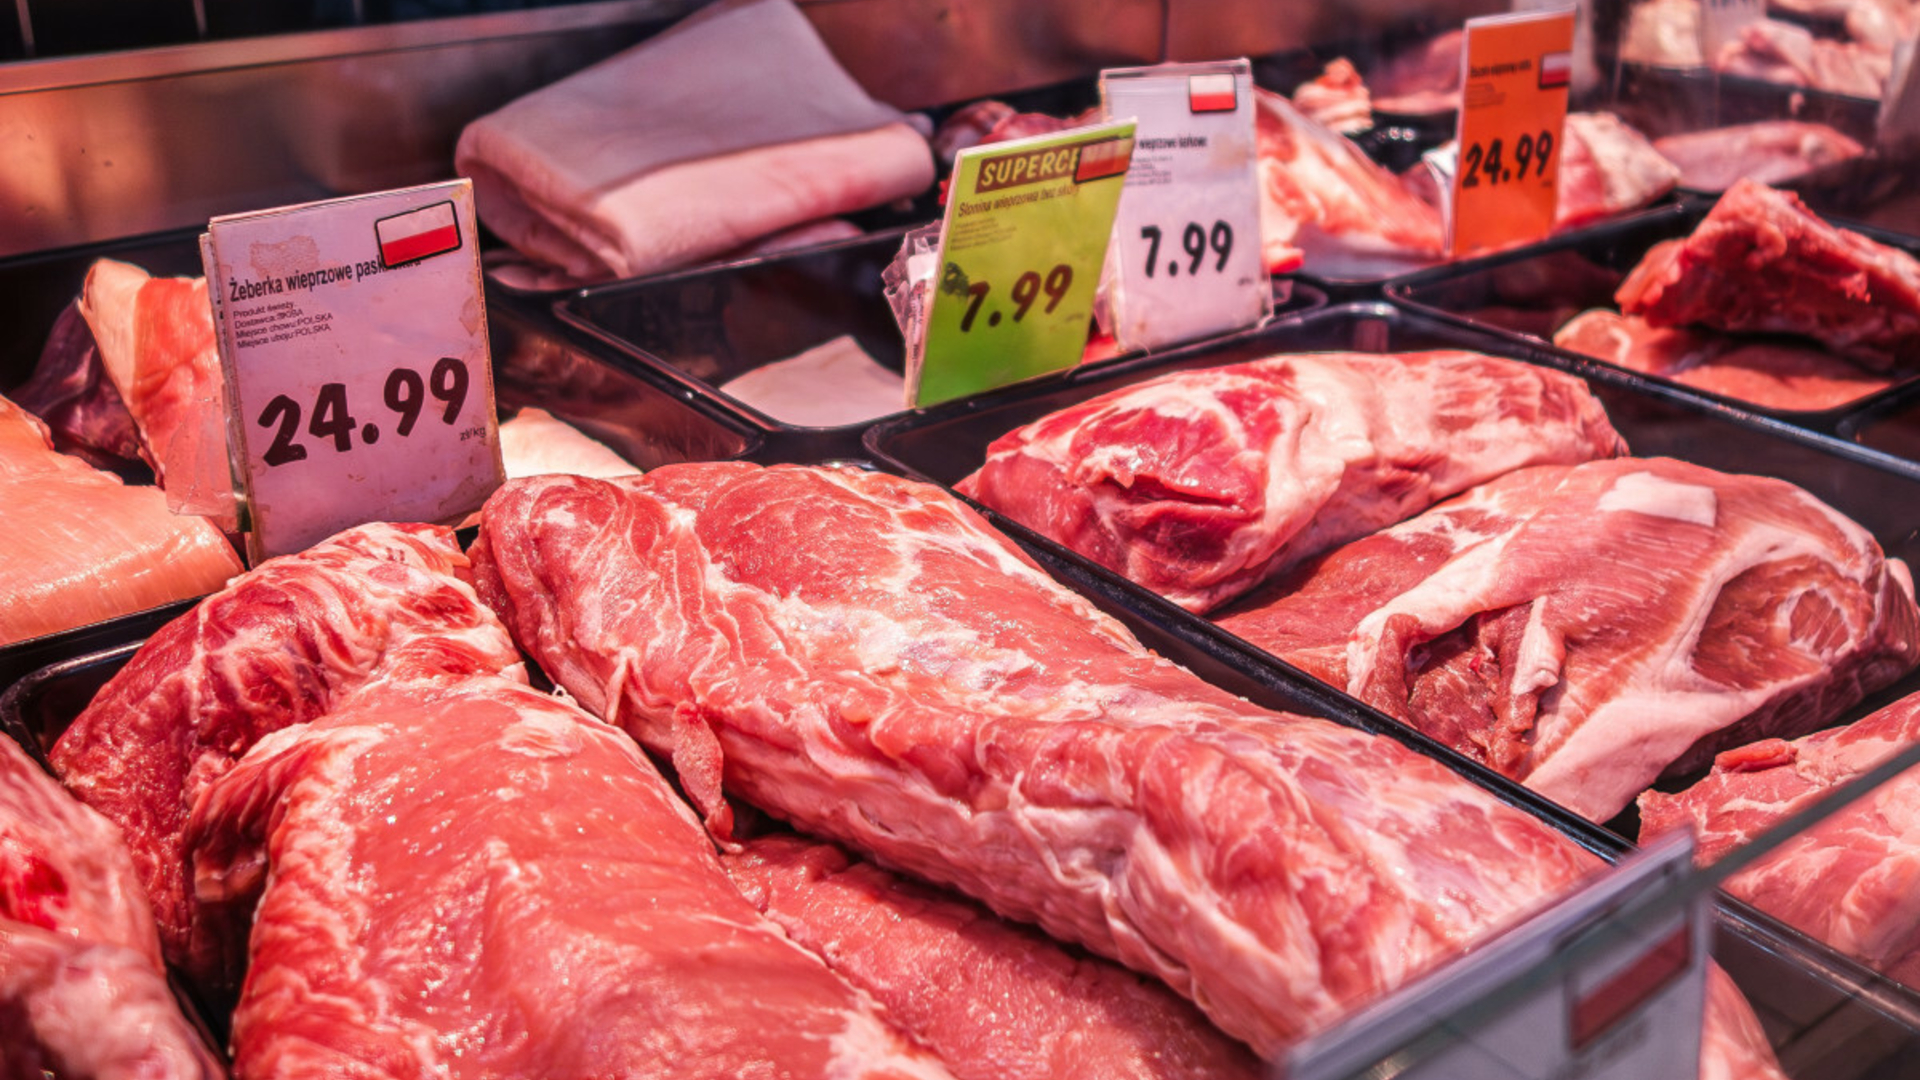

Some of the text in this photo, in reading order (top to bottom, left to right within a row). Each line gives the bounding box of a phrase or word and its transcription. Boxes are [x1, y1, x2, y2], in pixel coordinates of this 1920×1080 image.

[1462, 130, 1553, 188] 24.99
[1140, 220, 1233, 278] 7.99
[229, 275, 283, 302] Żeberka
[285, 265, 353, 292] wieprzowe
[960, 264, 1073, 332] 7.99
[235, 327, 267, 339] Miejsce
[237, 336, 269, 349] Miejsce
[257, 357, 469, 467] 24.99
